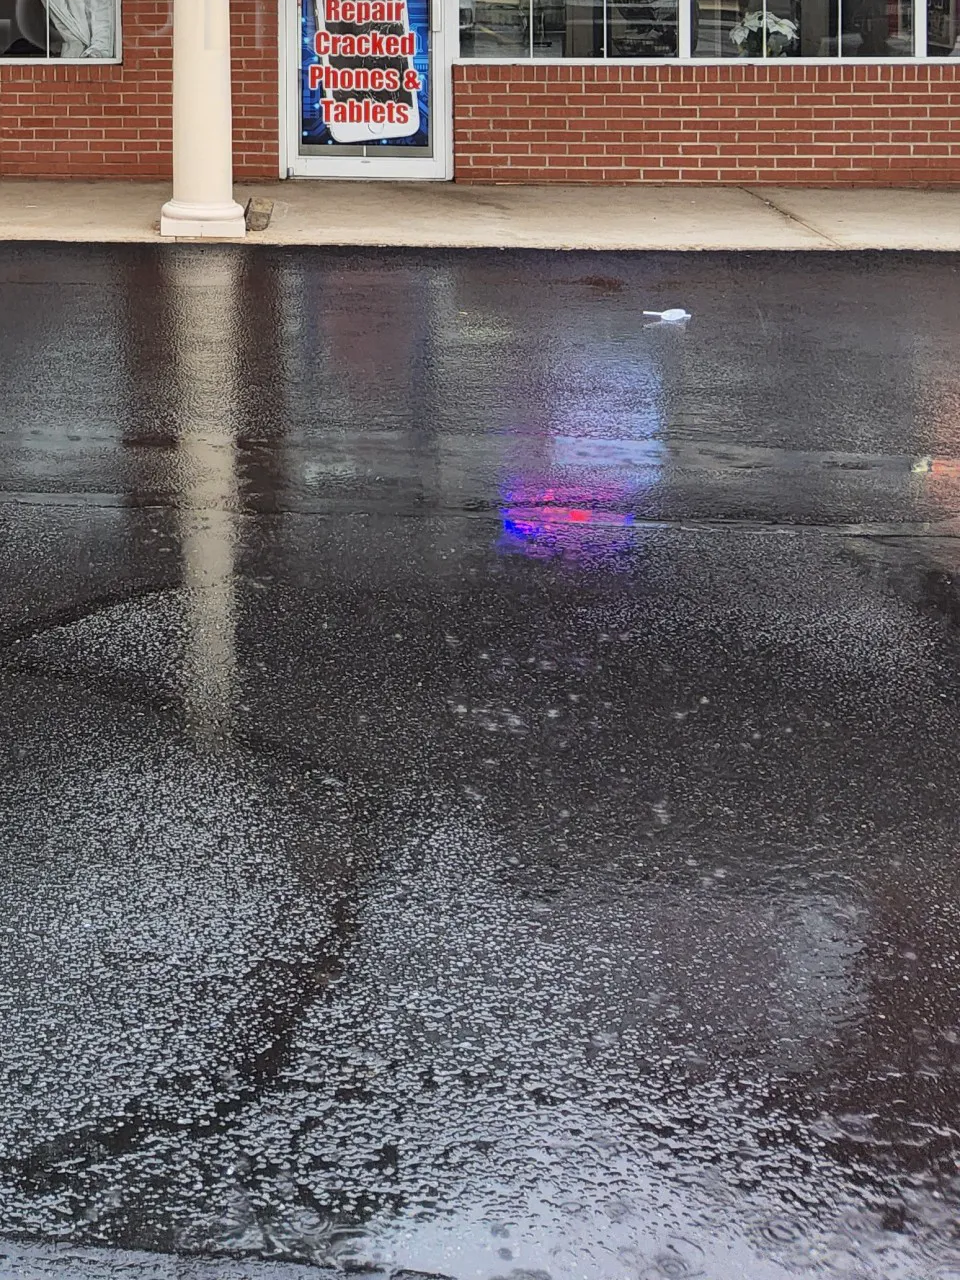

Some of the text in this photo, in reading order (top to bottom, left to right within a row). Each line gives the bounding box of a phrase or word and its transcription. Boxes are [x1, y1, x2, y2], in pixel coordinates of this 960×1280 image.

[315, 32, 415, 56] Cracked
[309, 66, 420, 90] Phones &
[321, 99, 409, 124] Tablets
